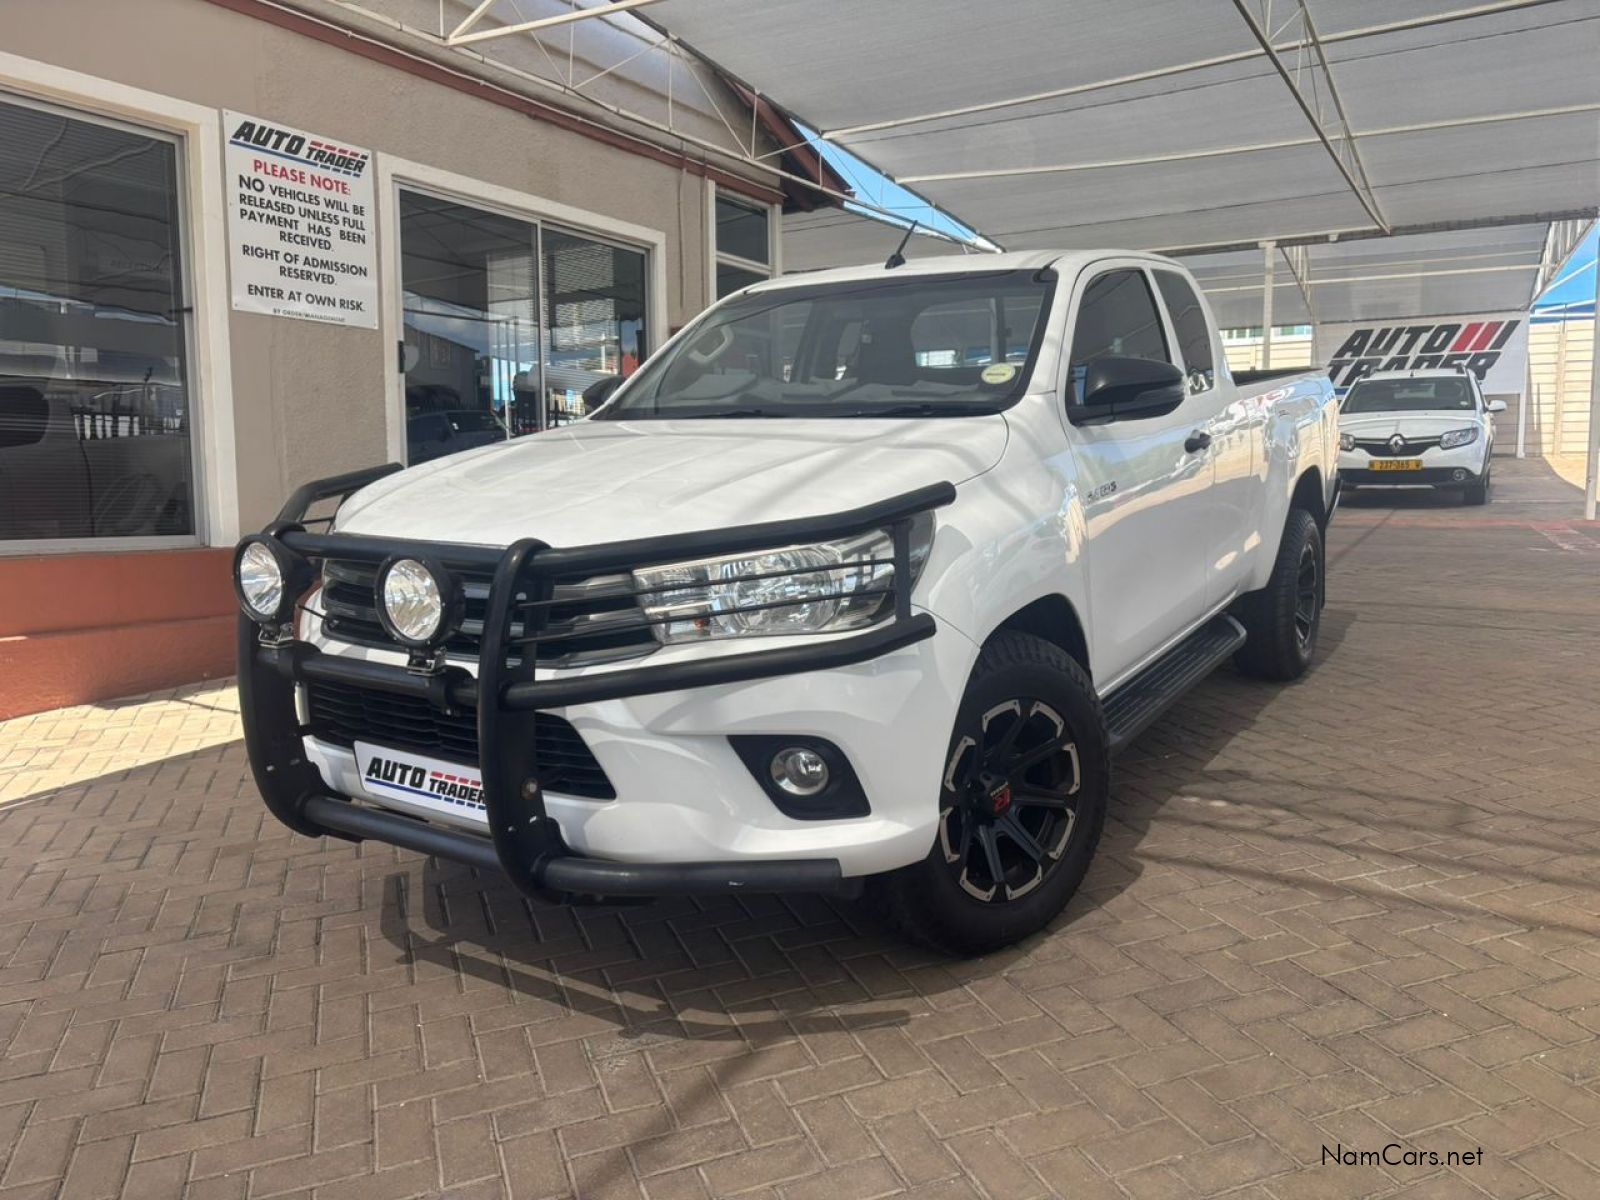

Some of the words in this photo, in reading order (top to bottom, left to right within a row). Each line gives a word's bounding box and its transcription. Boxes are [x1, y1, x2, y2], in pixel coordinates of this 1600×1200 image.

[232, 121, 306, 155] AUTO
[305, 147, 366, 172] TRADER
[239, 174, 265, 192] NO
[269, 184, 320, 205] VEHICLES
[323, 197, 349, 213] WILL
[352, 204, 365, 216] BE
[253, 159, 306, 184] PLEASE
[310, 174, 351, 195] NOTE:
[239, 193, 295, 215] RELEASED
[298, 206, 339, 225] UNLESS
[342, 216, 366, 231] FULL
[240, 208, 299, 230] PAYMENT
[308, 222, 331, 237] HAS
[339, 229, 366, 244] BEEN
[279, 230, 334, 252] RECEIVED.
[242, 244, 280, 260] RIGHT
[283, 252, 300, 264] OF
[303, 256, 368, 277] ADMISSION
[279, 265, 338, 286] RESERVED.
[247, 283, 284, 300] ENTER
[288, 290, 302, 302] AT
[305, 293, 337, 308] OWN
[339, 300, 366, 312] RISK.
[1332, 323, 1462, 359] AUTO
[366, 757, 427, 788] AUTO
